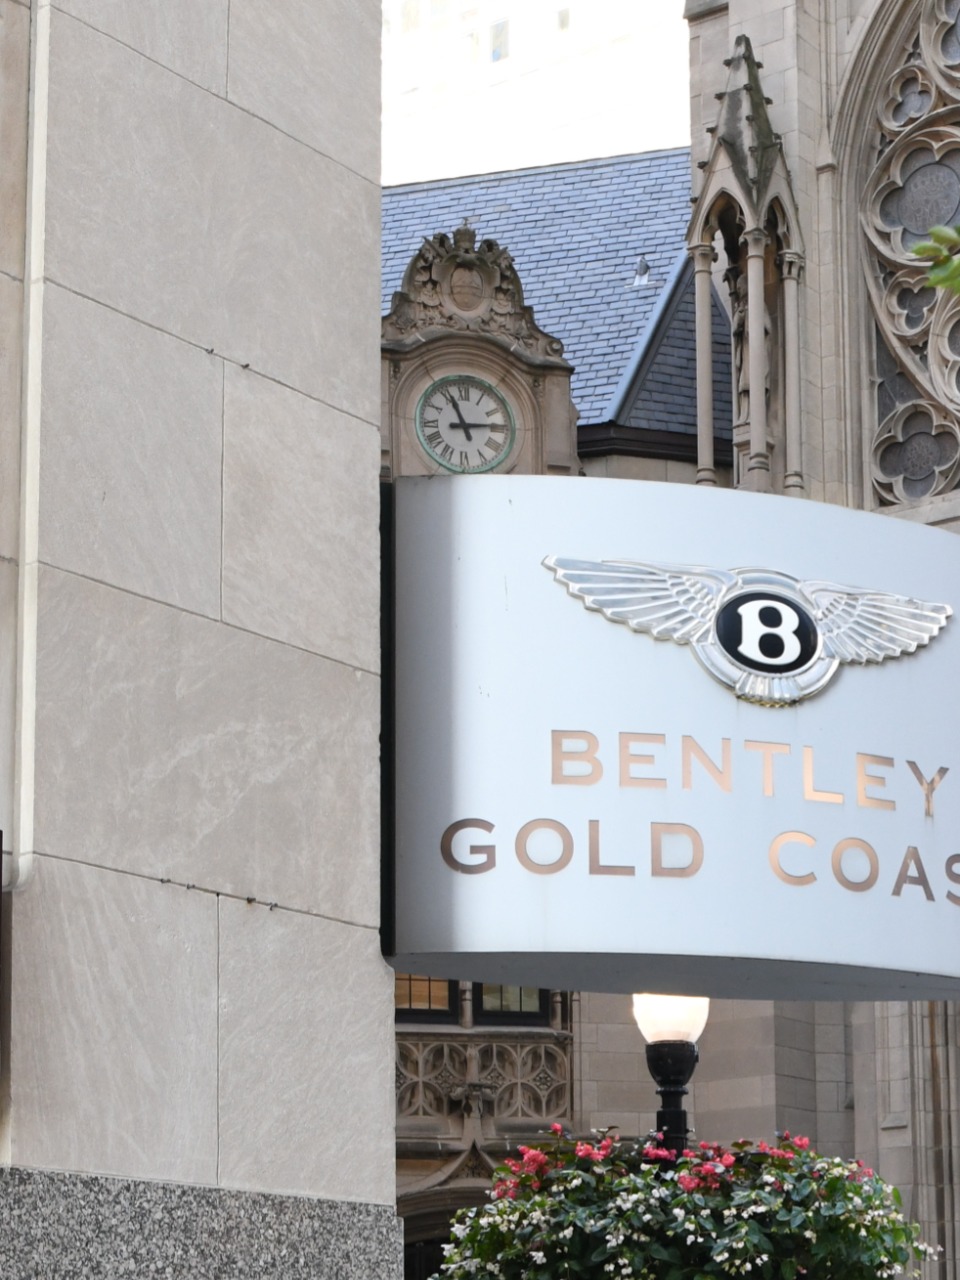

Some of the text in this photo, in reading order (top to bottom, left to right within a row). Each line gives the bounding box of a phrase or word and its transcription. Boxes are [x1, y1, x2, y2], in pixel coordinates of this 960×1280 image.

[457, 386, 470, 402] XII
[426, 401, 443, 415] X
[485, 408, 500, 418] II
[423, 420, 439, 429] IX
[460, 451, 470, 467] VI
[477, 448, 488, 463] V
[736, 598, 802, 667] B
[550, 728, 951, 817] BENTLEY
[439, 817, 705, 878] GOLD
